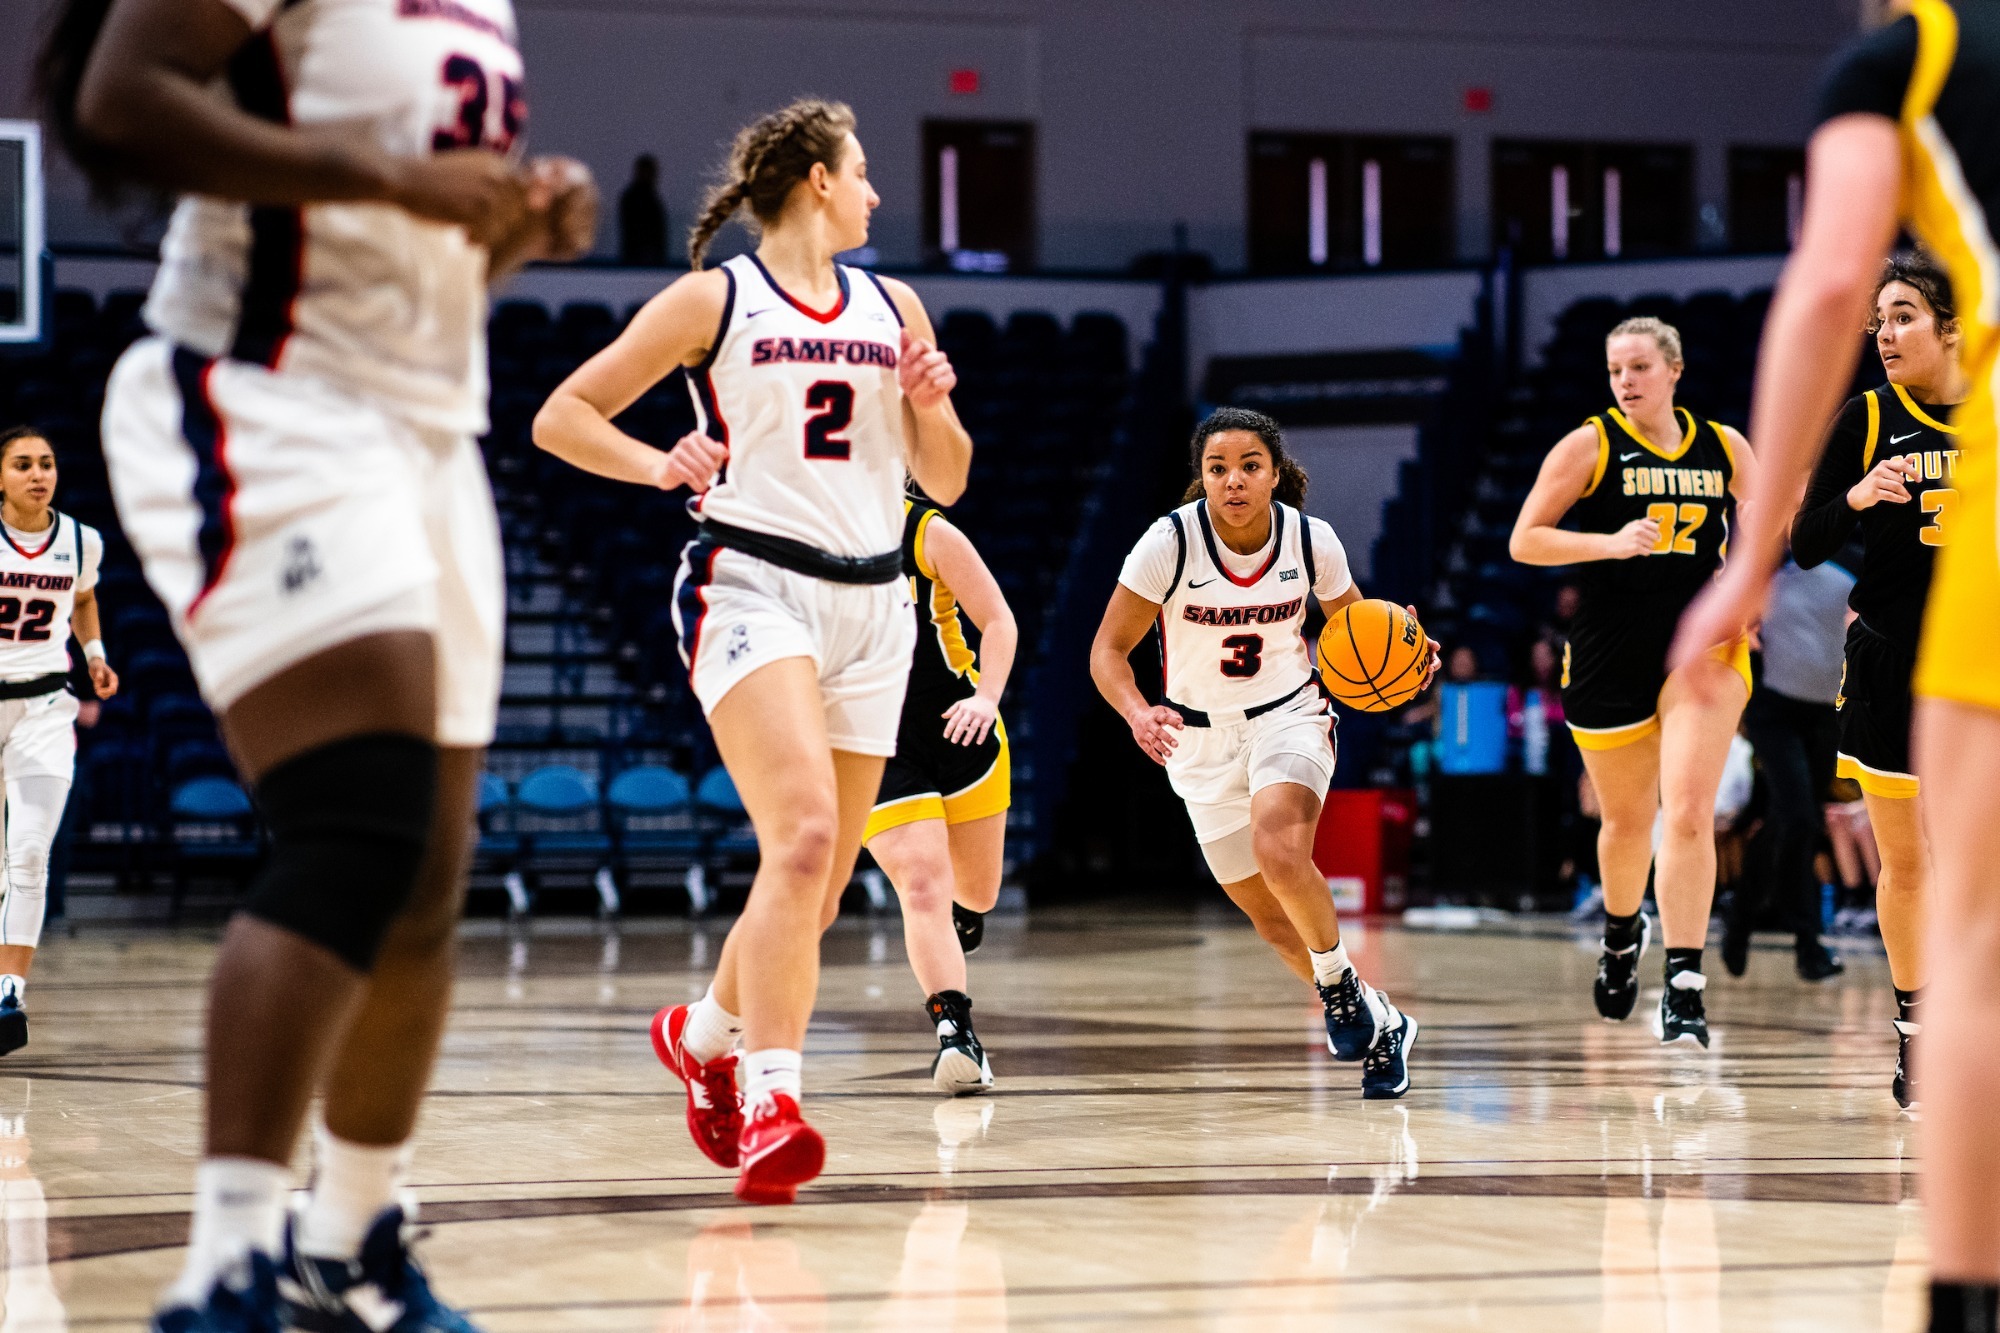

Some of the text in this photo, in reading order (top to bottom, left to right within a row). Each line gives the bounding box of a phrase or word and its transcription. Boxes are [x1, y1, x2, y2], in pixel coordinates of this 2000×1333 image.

[752, 338, 896, 369] SAMFORD
[805, 380, 854, 460] 2
[1623, 467, 1724, 498] SOUTHERN
[1646, 503, 1708, 554] 32
[0, 597, 56, 642] 22
[1183, 596, 1302, 626] SAMFORD
[1220, 633, 1263, 677] 3
